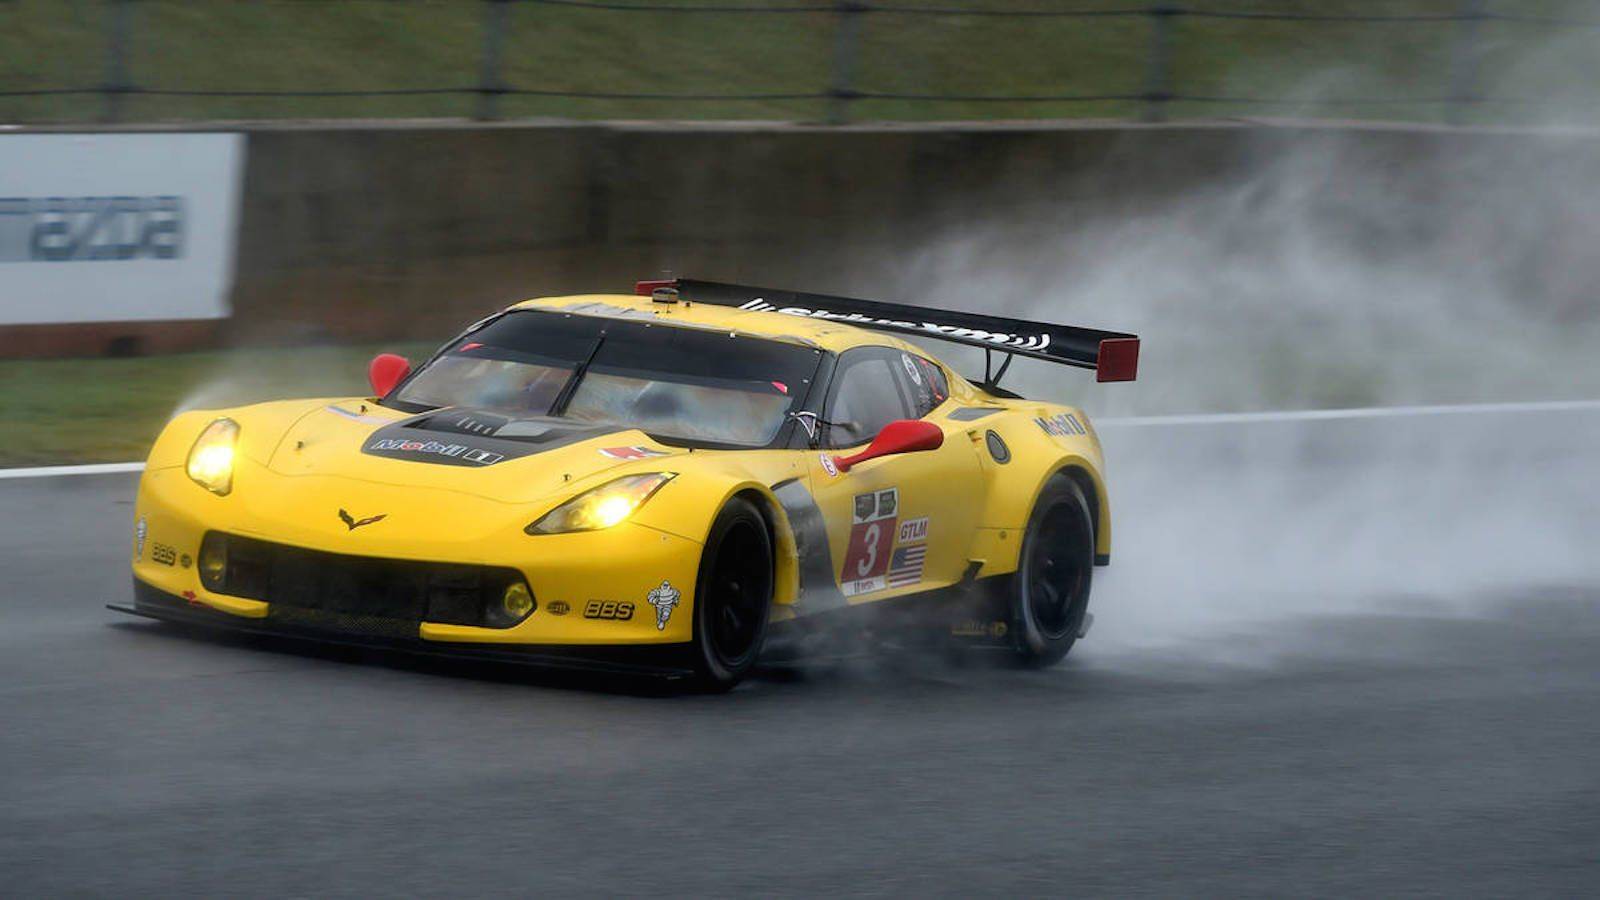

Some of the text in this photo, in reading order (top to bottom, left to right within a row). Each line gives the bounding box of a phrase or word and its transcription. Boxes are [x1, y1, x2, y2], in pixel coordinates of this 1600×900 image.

[371, 439, 468, 456] Mobil
[900, 520, 928, 540] GTLM
[152, 543, 176, 566] BBS
[858, 523, 880, 577] 3
[584, 600, 634, 620] BBS
